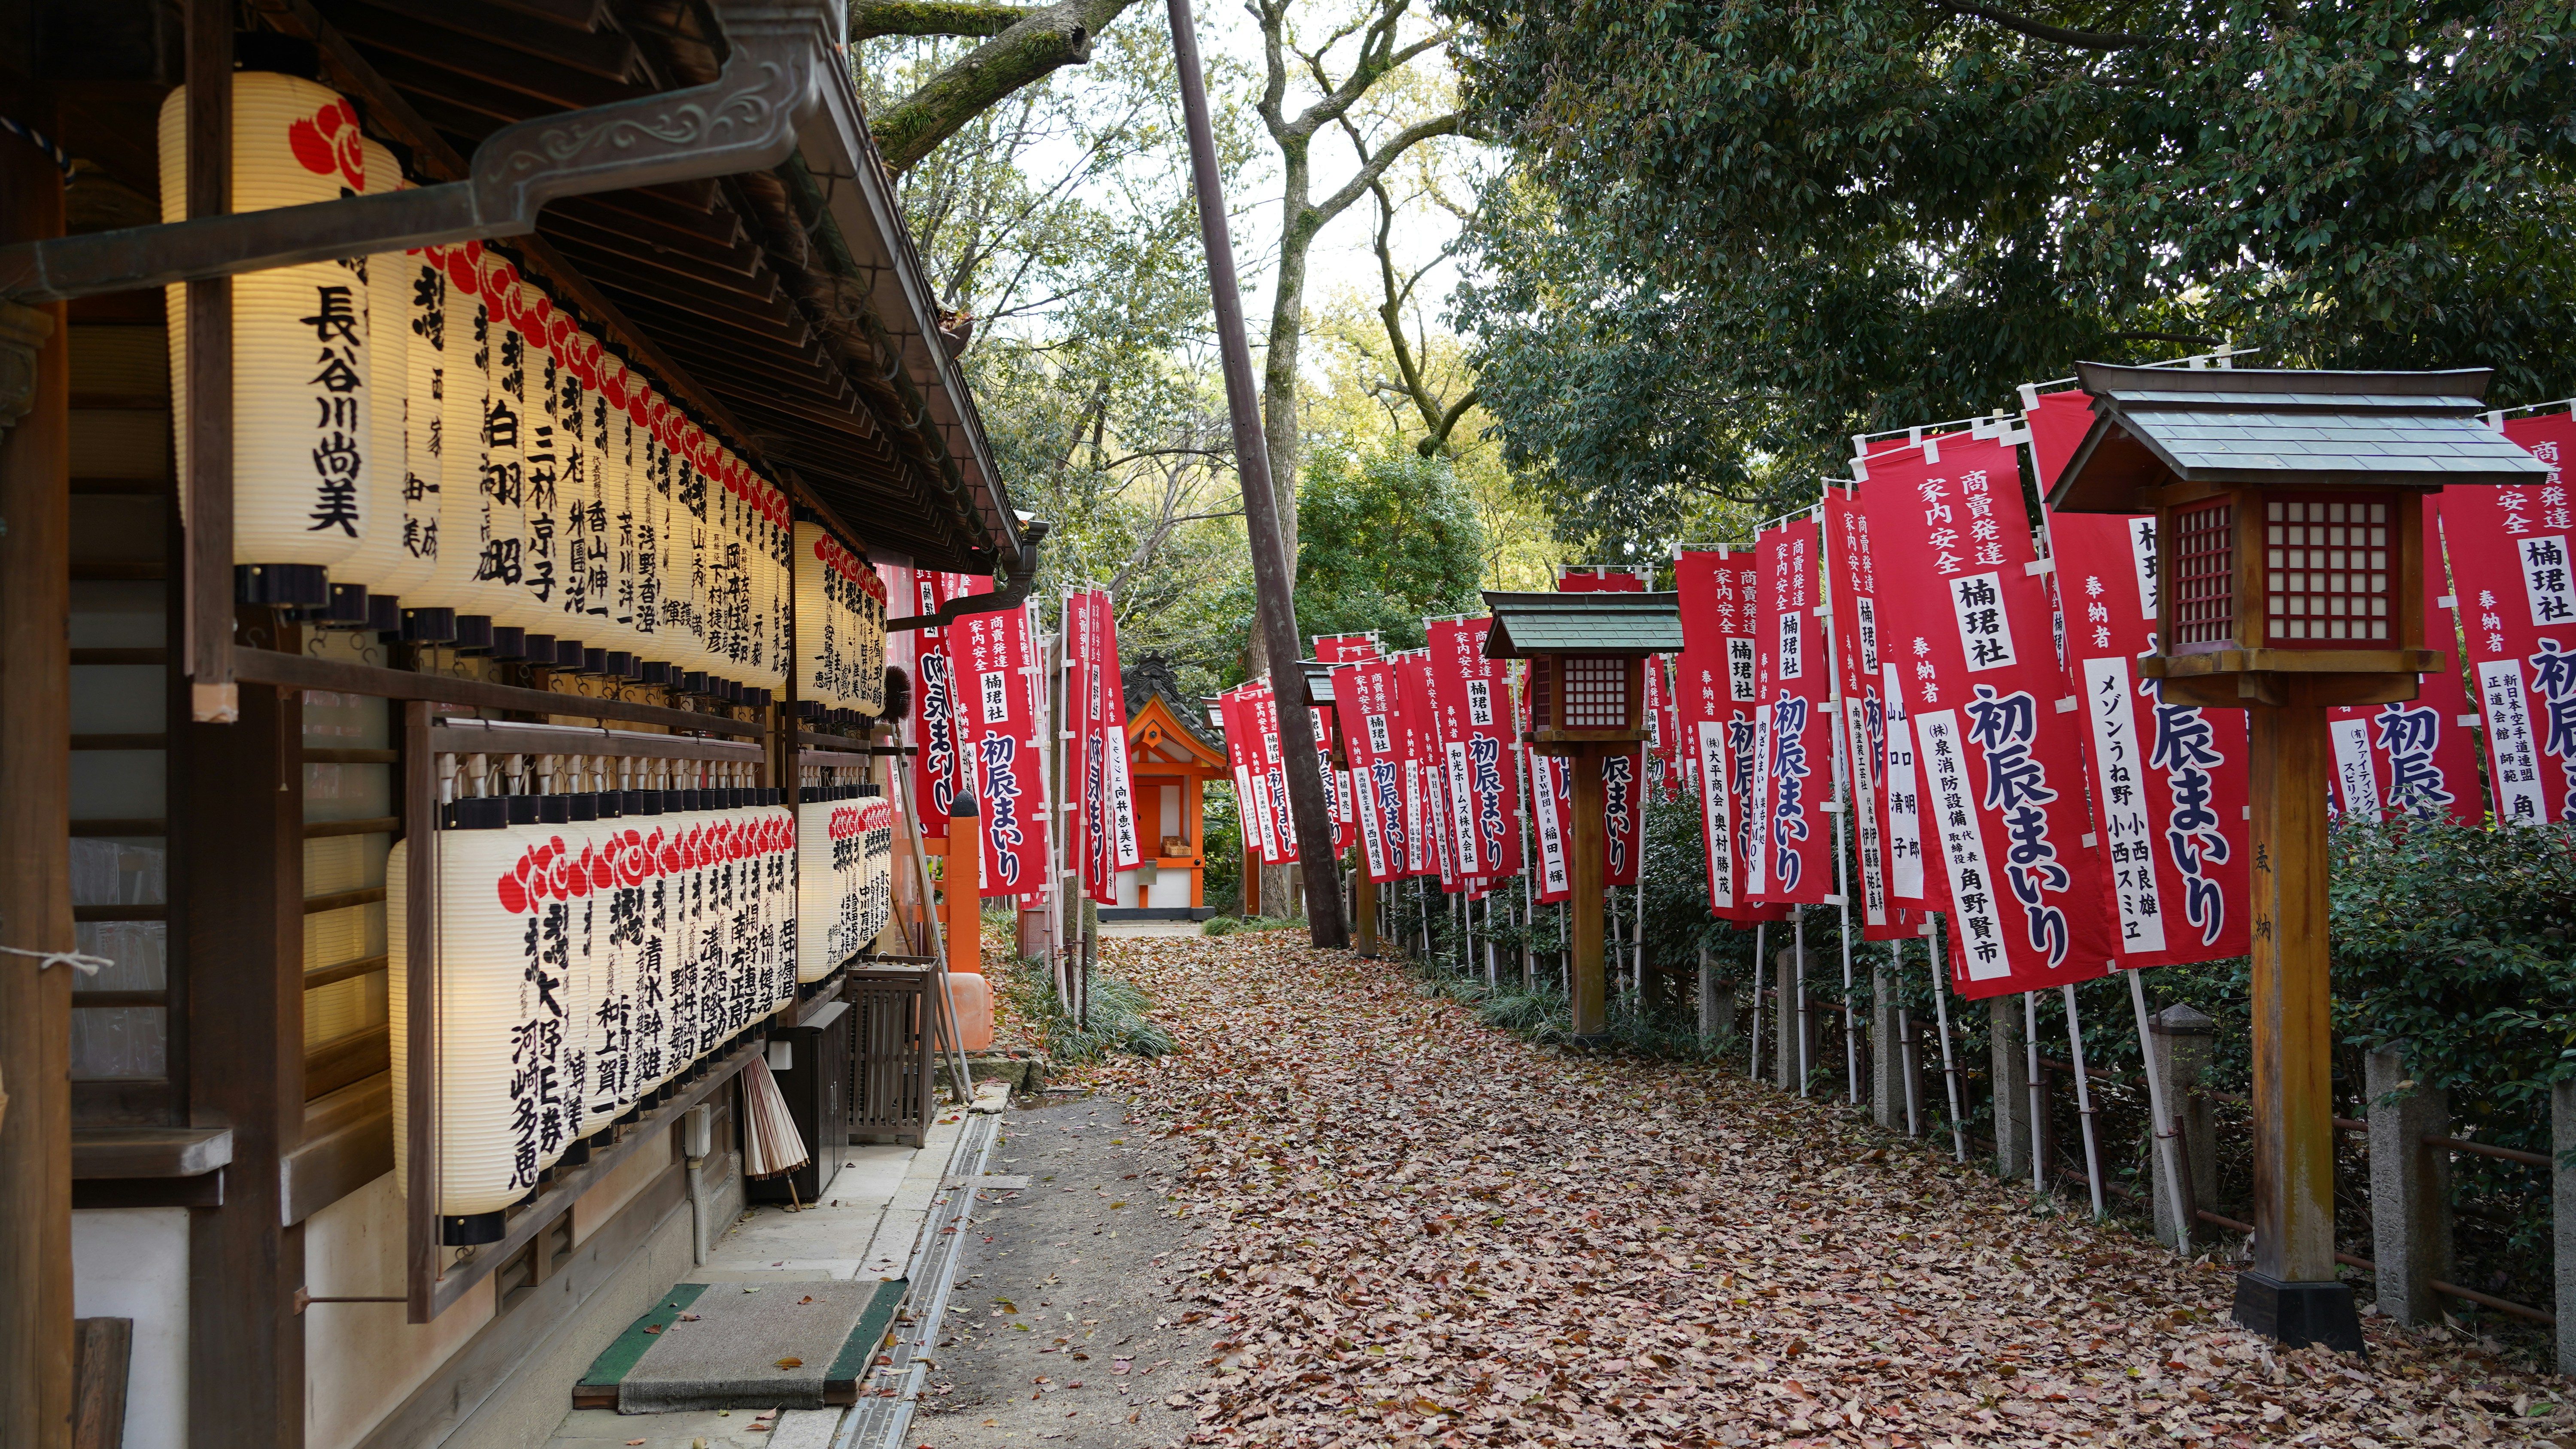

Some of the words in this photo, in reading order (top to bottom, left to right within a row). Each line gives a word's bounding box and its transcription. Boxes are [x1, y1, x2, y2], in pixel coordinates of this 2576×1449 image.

[301, 286, 362, 538] 長谷川尚美
[525, 425, 558, 603] 三林京子
[1844, 510, 1862, 592] 家内安全
[1917, 477, 1965, 575] 家内安全
[1959, 470, 2007, 566] 商賣発達
[586, 500, 608, 618] 香山伸一
[1775, 543, 1789, 612] 家内安全
[1791, 538, 1806, 607] 商賣発達
[1857, 514, 1874, 594] 商賣発達
[2527, 540, 2574, 622] 楠珺社
[1713, 567, 1737, 634] 家内安全
[1739, 569, 1757, 635] 商賣発達
[1860, 600, 1878, 672] 楠珺社
[1958, 578, 2010, 667] 楠珺社
[2084, 575, 2111, 649] 奉納者
[2479, 589, 2505, 653] 奉納者
[968, 619, 989, 672] 家内安全
[990, 615, 1009, 667] 商賣発達
[1454, 631, 1473, 678] 家内安全
[1730, 640, 1755, 700] 楠珺社
[1759, 652, 1768, 700] 奉納者
[1782, 615, 1799, 677] 楠珺社
[1912, 636, 1940, 704] 奉納者
[984, 673, 1005, 721] 楠珺社
[1255, 702, 1269, 734] 家内安全
[1354, 675, 1373, 715] 家内安全
[1372, 673, 1388, 712] 商賣発達
[1423, 666, 1438, 709] 家内安全
[1446, 705, 1458, 739] 奉納者
[1470, 682, 1491, 724] 楠珺社
[1701, 669, 1716, 716] 奉納者
[1352, 737, 1363, 765] 奉納者
[1370, 717, 1388, 751] 楠珺社
[1406, 728, 1415, 757] 奉納者
[1425, 733, 1434, 763] 奉納者
[1852, 706, 1868, 791] 南海塗装工芸社
[2099, 675, 2134, 806] メゾンうね野
[2487, 676, 2510, 741] 正道会館
[2499, 752, 2519, 783] 師範
[2502, 674, 2536, 782] 新日本空手道連盟
[979, 729, 1024, 887] 初辰まいり
[1450, 749, 1475, 864] 和光ホームズ株式会社
[1468, 731, 1504, 871] 初辰まいり
[1706, 737, 1725, 807] (株)大平商会
[1771, 688, 1811, 893] 初辰まいり
[1887, 703, 1908, 859] 山口清子
[1929, 722, 1967, 828] (株)泉消防設備
[1367, 829, 1382, 870] 西岡靖浩
[1372, 758, 1405, 874] 初辰まいり
[1749, 797, 1759, 873] ALMON
[1964, 683, 2059, 969] 初辰まいり
[1544, 826, 1564, 884] 稲田一輝
[1713, 812, 1731, 895] 奥村勝茂
[2127, 812, 2158, 918] 小西良雄
[1959, 867, 1999, 964] 角野賢市
[726, 909, 746, 1031] 南方正良
[781, 918, 796, 1001] 田中康臣
[591, 997, 620, 1114] 和上賀一
